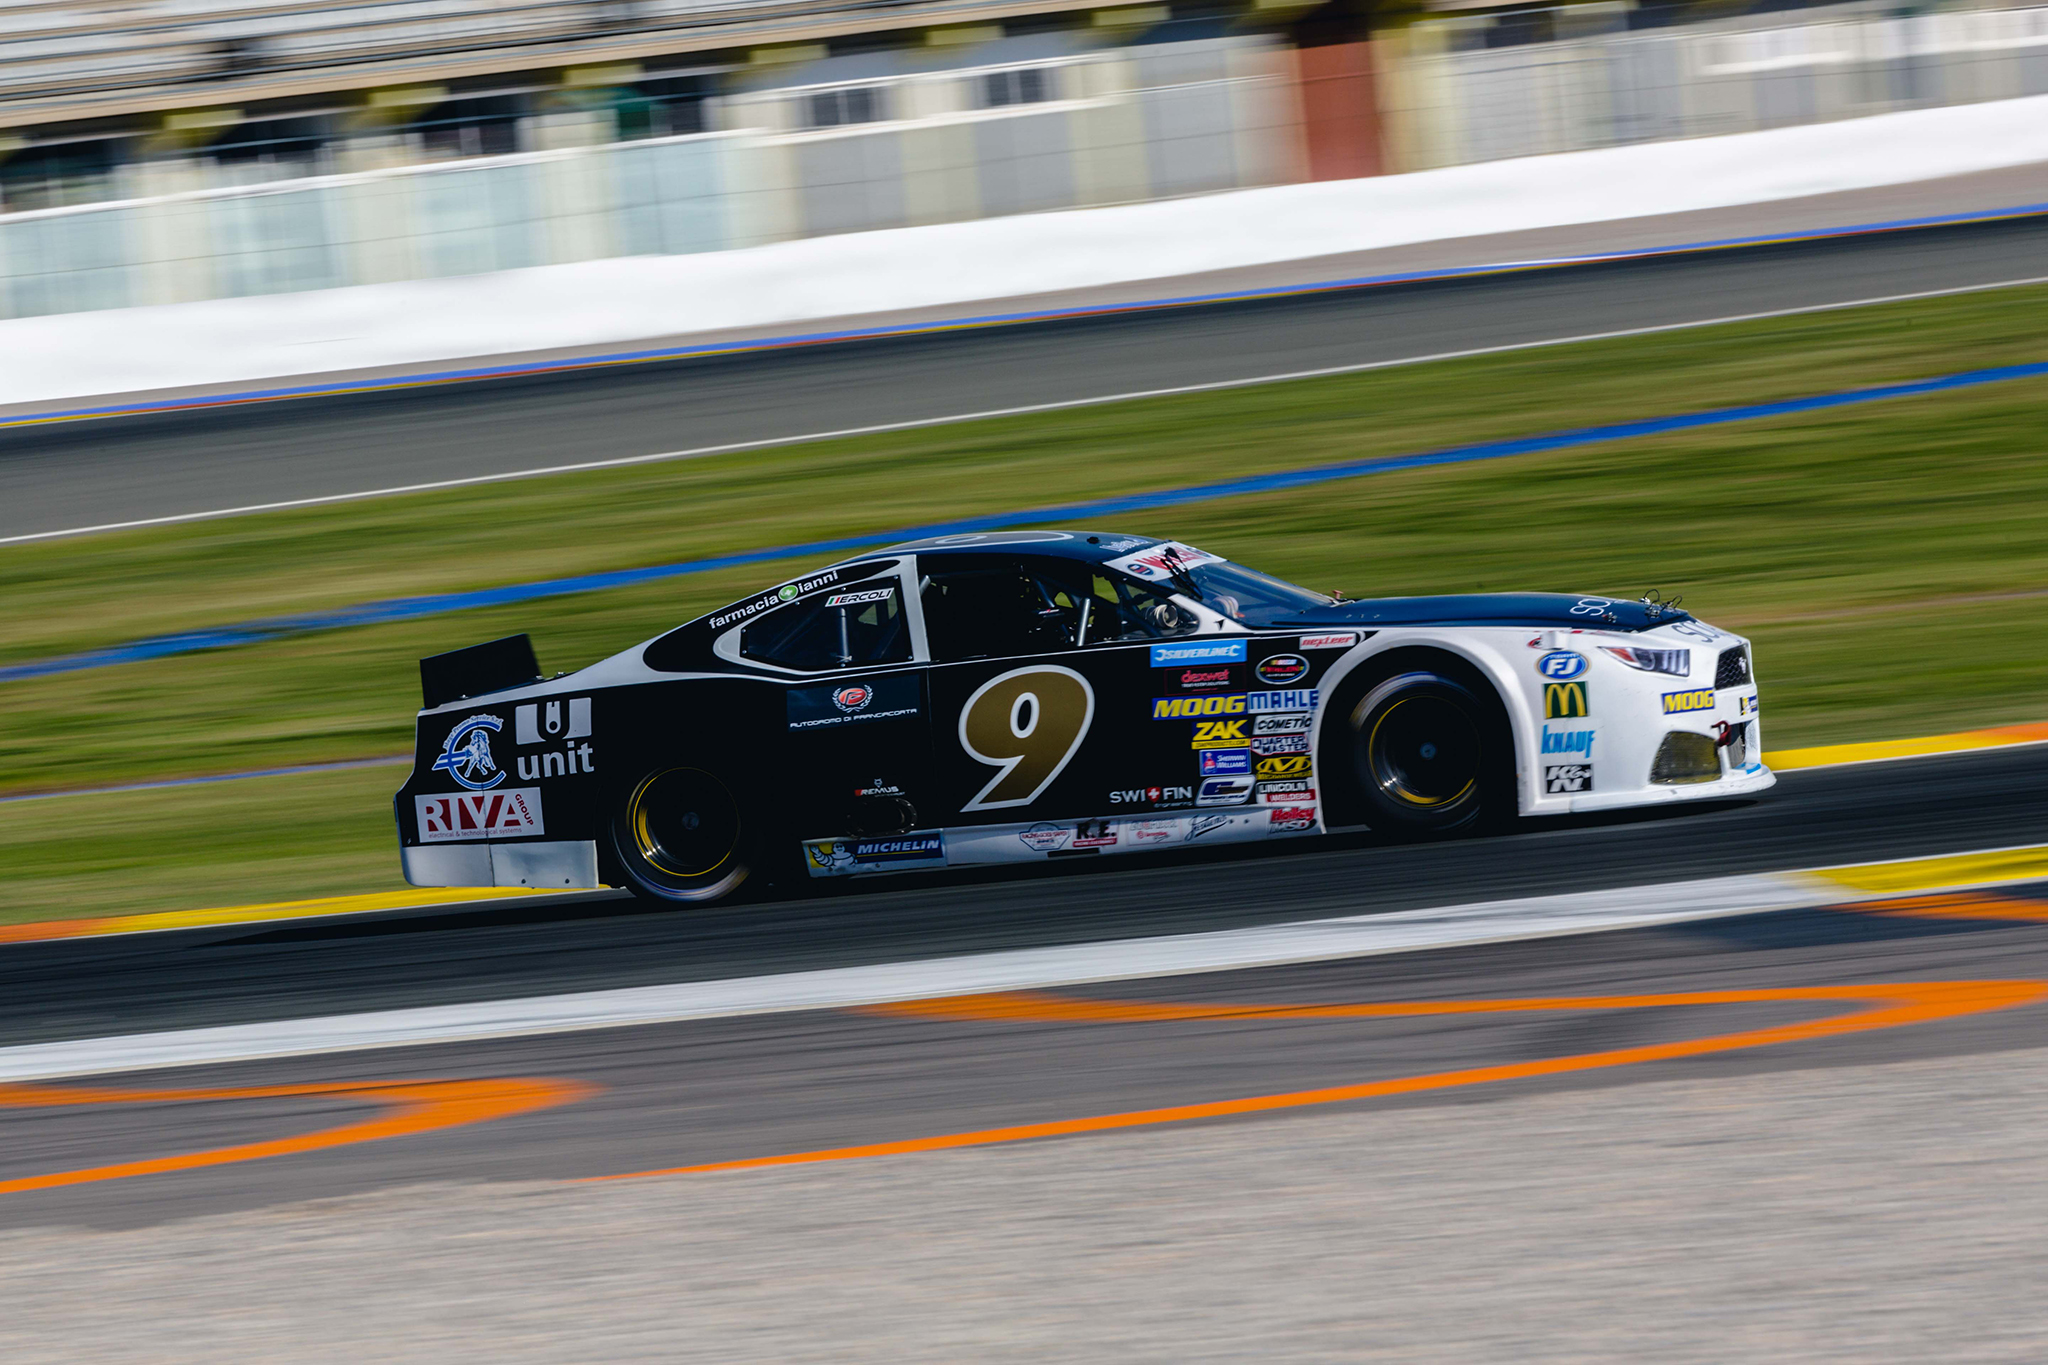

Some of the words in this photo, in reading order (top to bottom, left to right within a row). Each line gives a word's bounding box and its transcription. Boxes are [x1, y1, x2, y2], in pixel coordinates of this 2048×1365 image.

[709, 594, 779, 629] farmacia
[798, 570, 839, 594] ianni
[1301, 636, 1354, 647] nexteer
[1165, 646, 1231, 659] SILVERLINE
[1545, 658, 1579, 675] FJ
[1181, 669, 1230, 683] dexwet
[1153, 695, 1247, 719] MOOG
[1250, 690, 1319, 710] MAHLE
[1664, 690, 1714, 713] MOOG
[790, 717, 842, 728] AUTODROMO
[853, 708, 918, 721] FRANCIACORTA
[1257, 717, 1312, 730] COMETIC
[1192, 720, 1248, 741] ZAK
[958, 664, 1095, 813] 9
[1253, 735, 1305, 750] QUARTER
[1262, 743, 1309, 753] MASTER
[517, 741, 595, 780] unit
[861, 786, 899, 796] REMUS
[1259, 782, 1306, 793] LINCOLN
[1269, 792, 1312, 802] WELDERS
[423, 795, 522, 832] RIVA
[514, 793, 534, 826] GROUP
[1270, 807, 1316, 822] Holley
[461, 829, 498, 837] technological
[1269, 820, 1311, 834] MSD
[857, 839, 939, 855] MICHELIN
